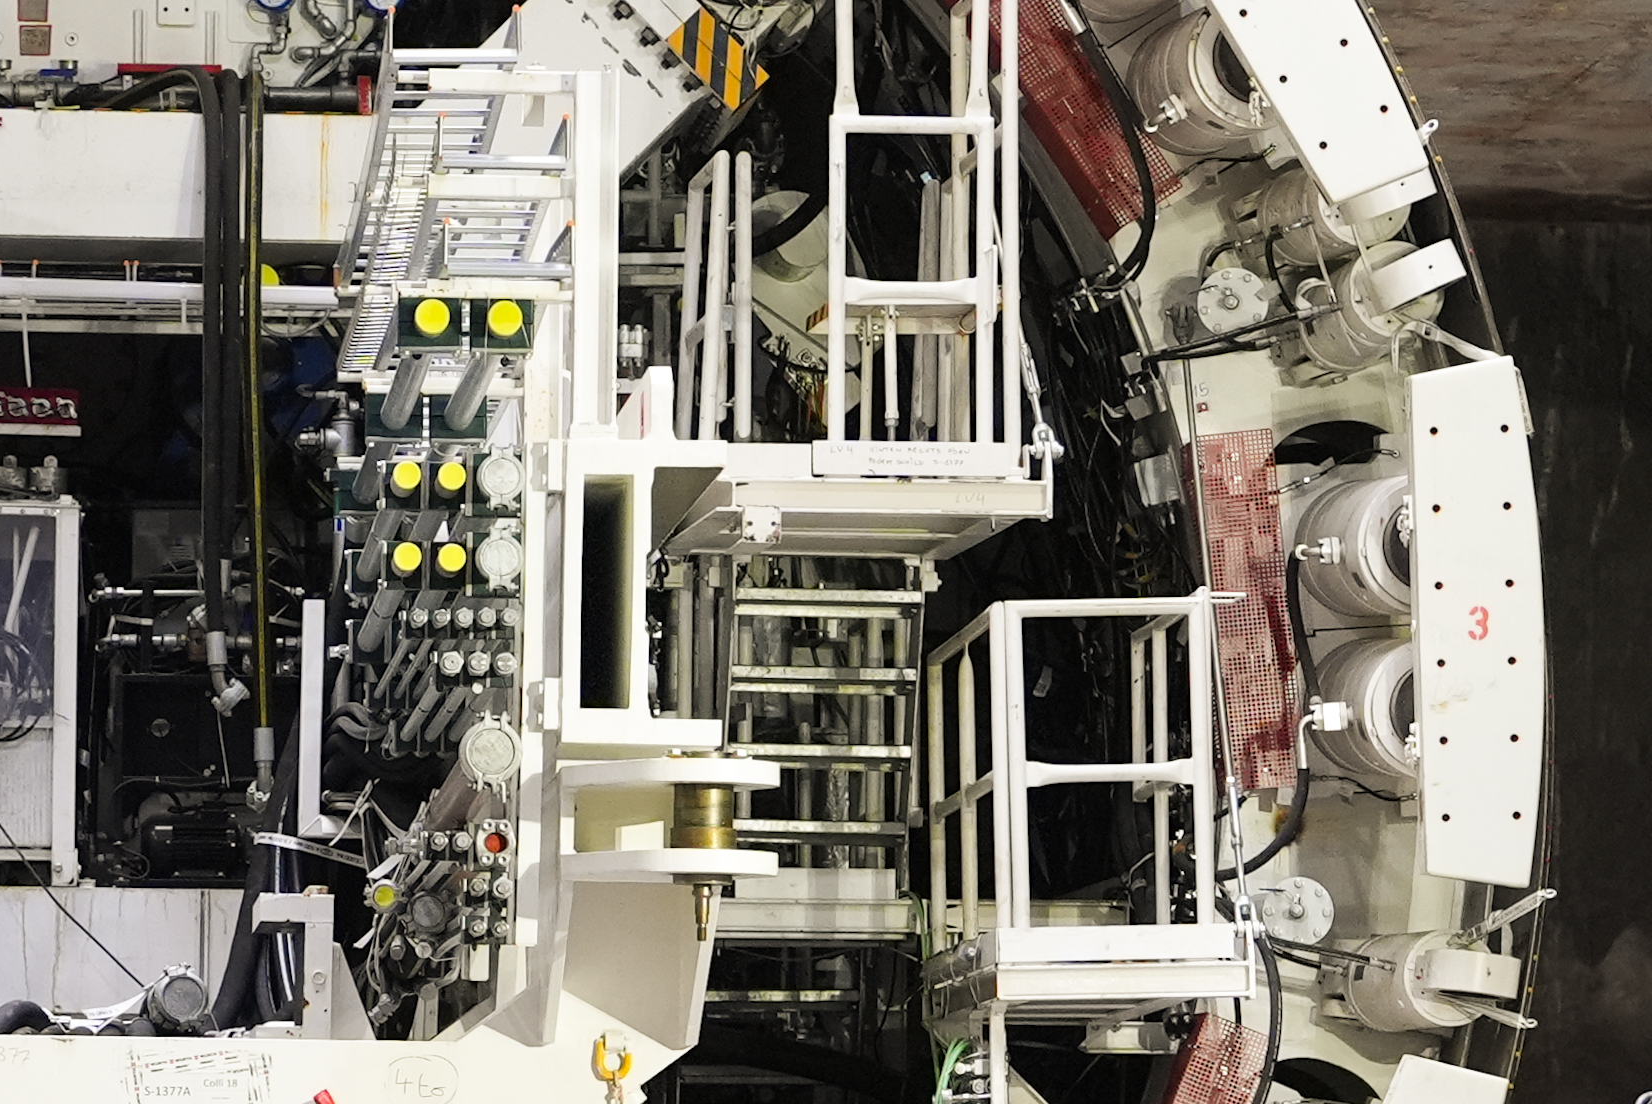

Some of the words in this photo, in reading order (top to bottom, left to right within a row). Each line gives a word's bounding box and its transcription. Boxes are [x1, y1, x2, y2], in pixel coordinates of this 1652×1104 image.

[1194, 381, 1209, 398] 15
[1468, 606, 1489, 641] 3
[203, 1078, 224, 1088] Colli
[227, 1078, 238, 1088] 18
[395, 1068, 413, 1094] 4
[144, 1086, 192, 1097] S-1377A
